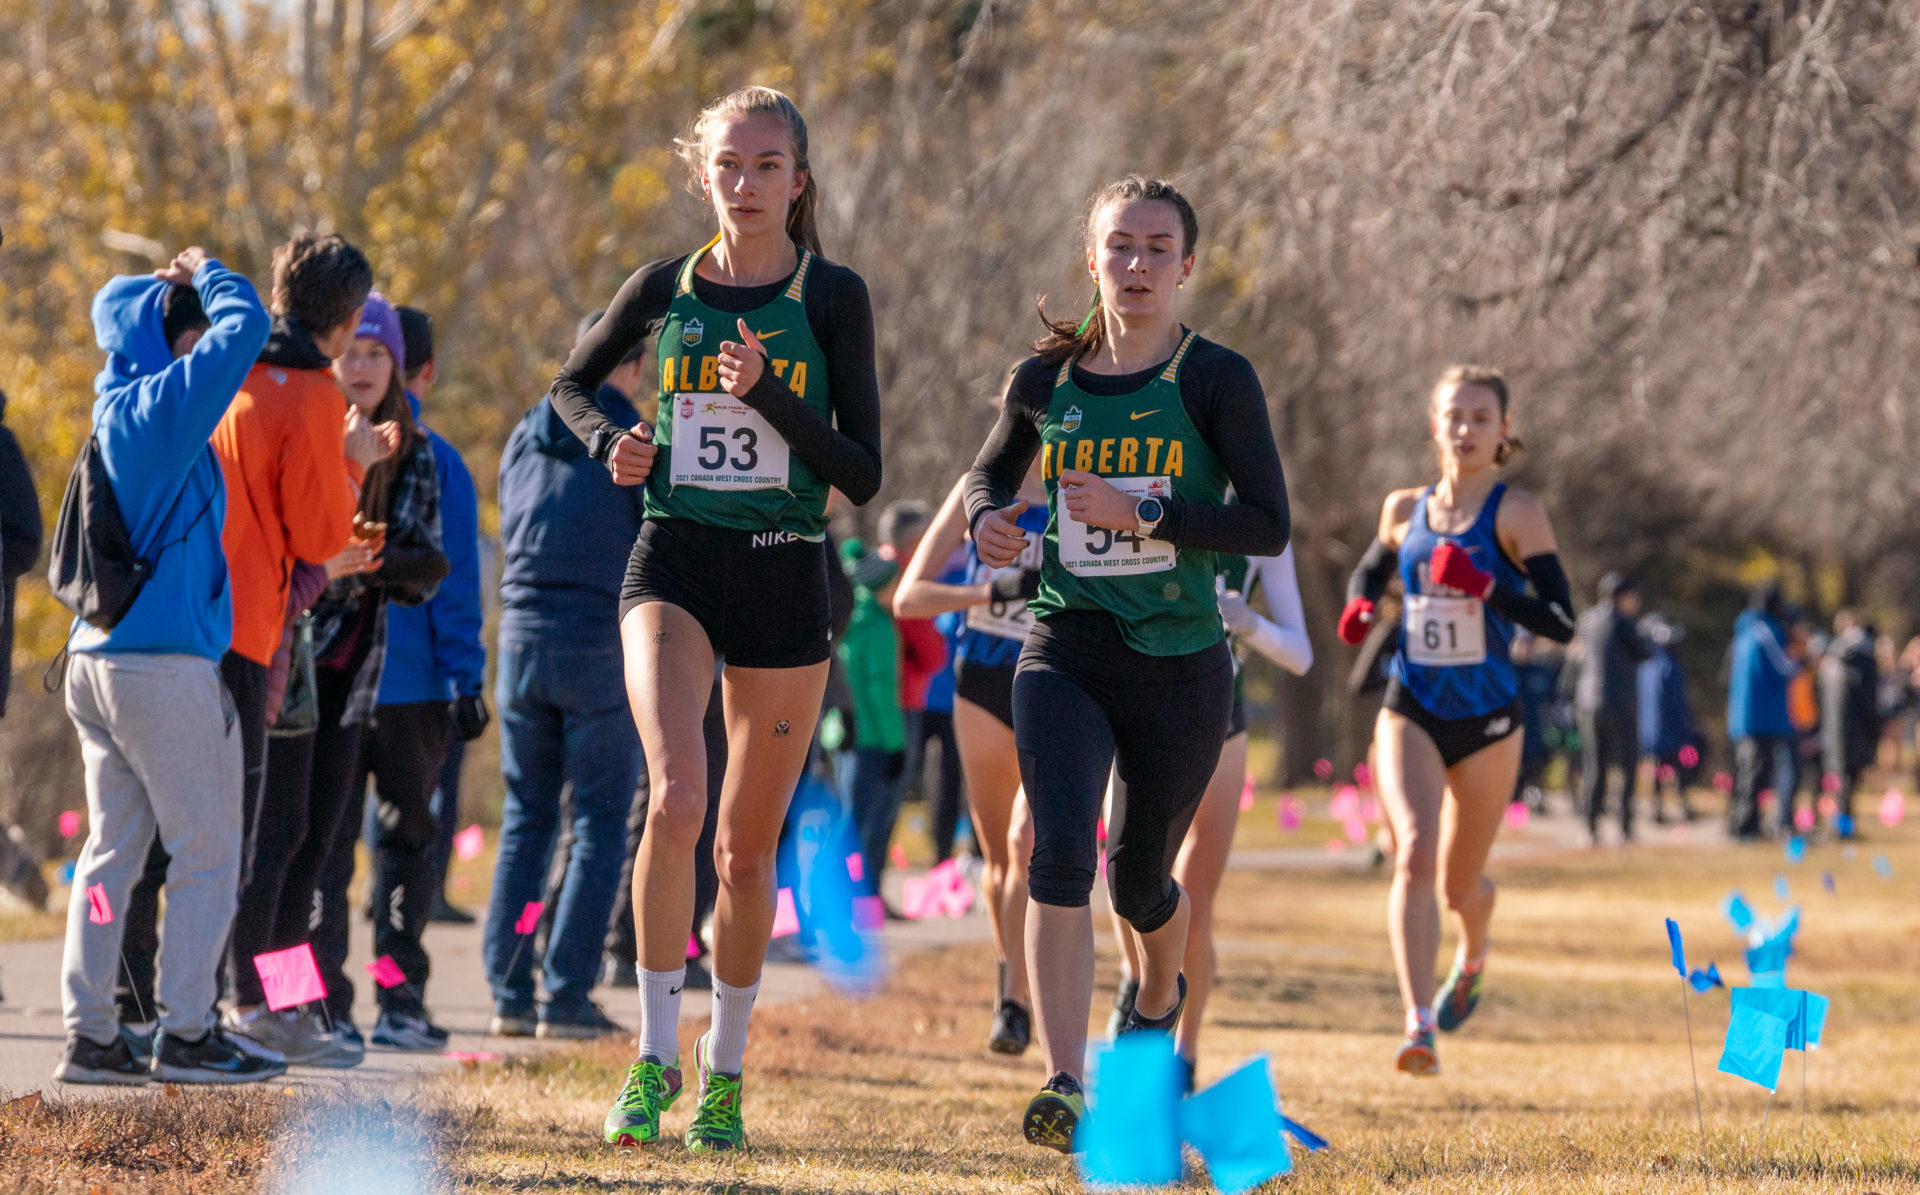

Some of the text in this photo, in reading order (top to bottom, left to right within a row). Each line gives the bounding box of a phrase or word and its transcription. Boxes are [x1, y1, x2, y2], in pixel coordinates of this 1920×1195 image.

[663, 355, 807, 398] ALBTA
[698, 426, 758, 471] 53
[1042, 437, 1183, 480] ALBERTA
[676, 474, 782, 485] 2021 CANADA WEST CROSS COUNTRY
[752, 531, 798, 548] NIKE
[1080, 560, 1102, 568] CANADA
[1103, 559, 1120, 567] WEST
[1121, 558, 1141, 567] CROSS
[1142, 555, 1169, 565] COUNTRY
[1424, 620, 1457, 651] 61
